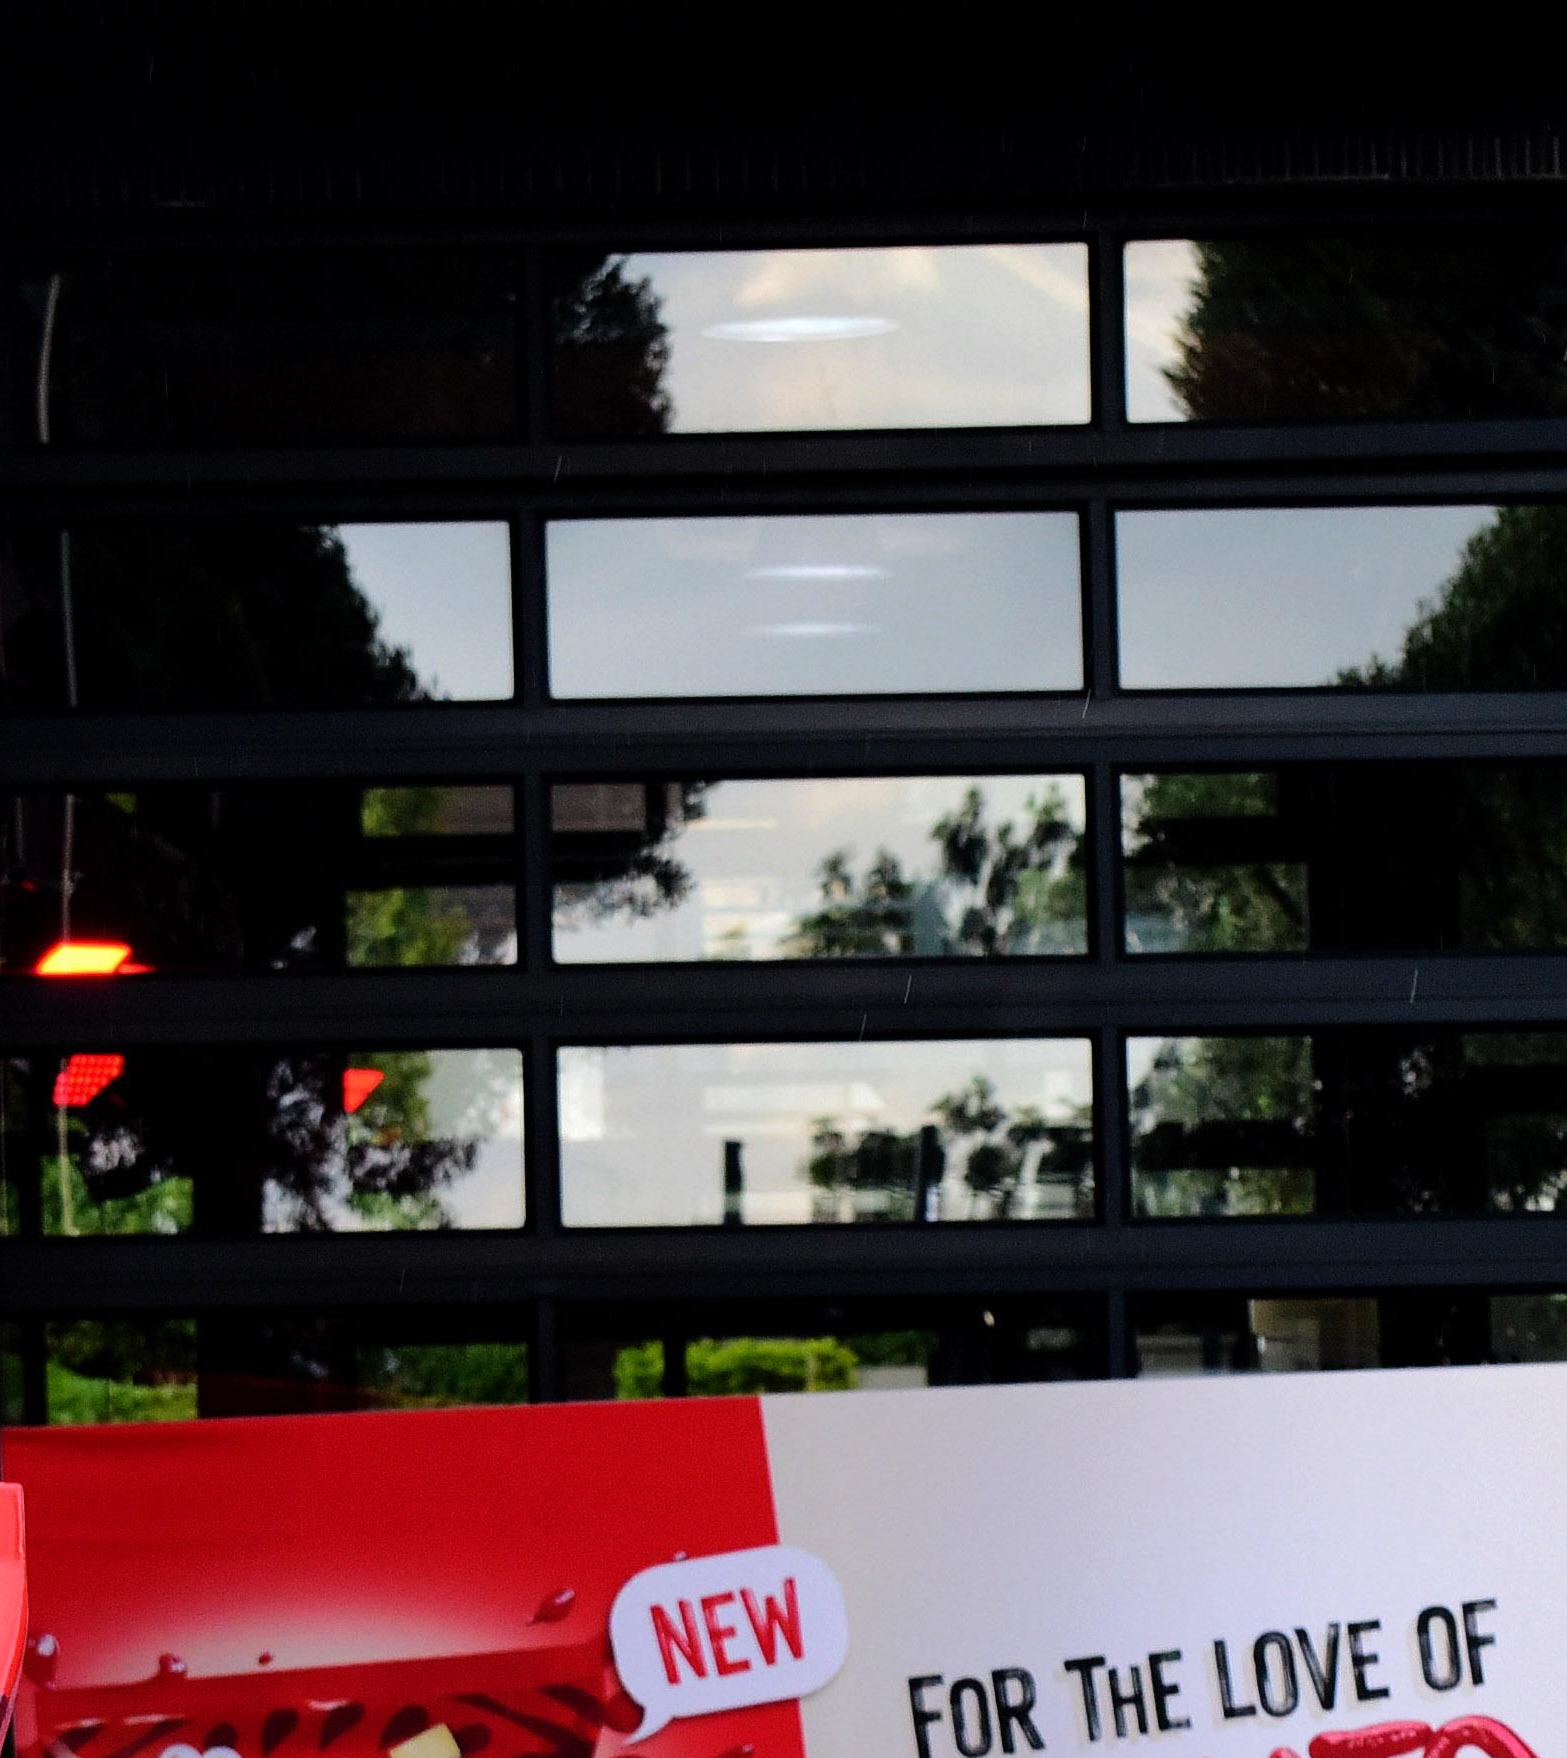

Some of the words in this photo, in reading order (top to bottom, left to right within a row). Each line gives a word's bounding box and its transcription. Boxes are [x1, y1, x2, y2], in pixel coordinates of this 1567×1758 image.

[649, 1576, 805, 1686] NEW
[1064, 1649, 1192, 1743] THE
[1213, 1619, 1391, 1720] LOVE
[1416, 1598, 1498, 1694] OF
